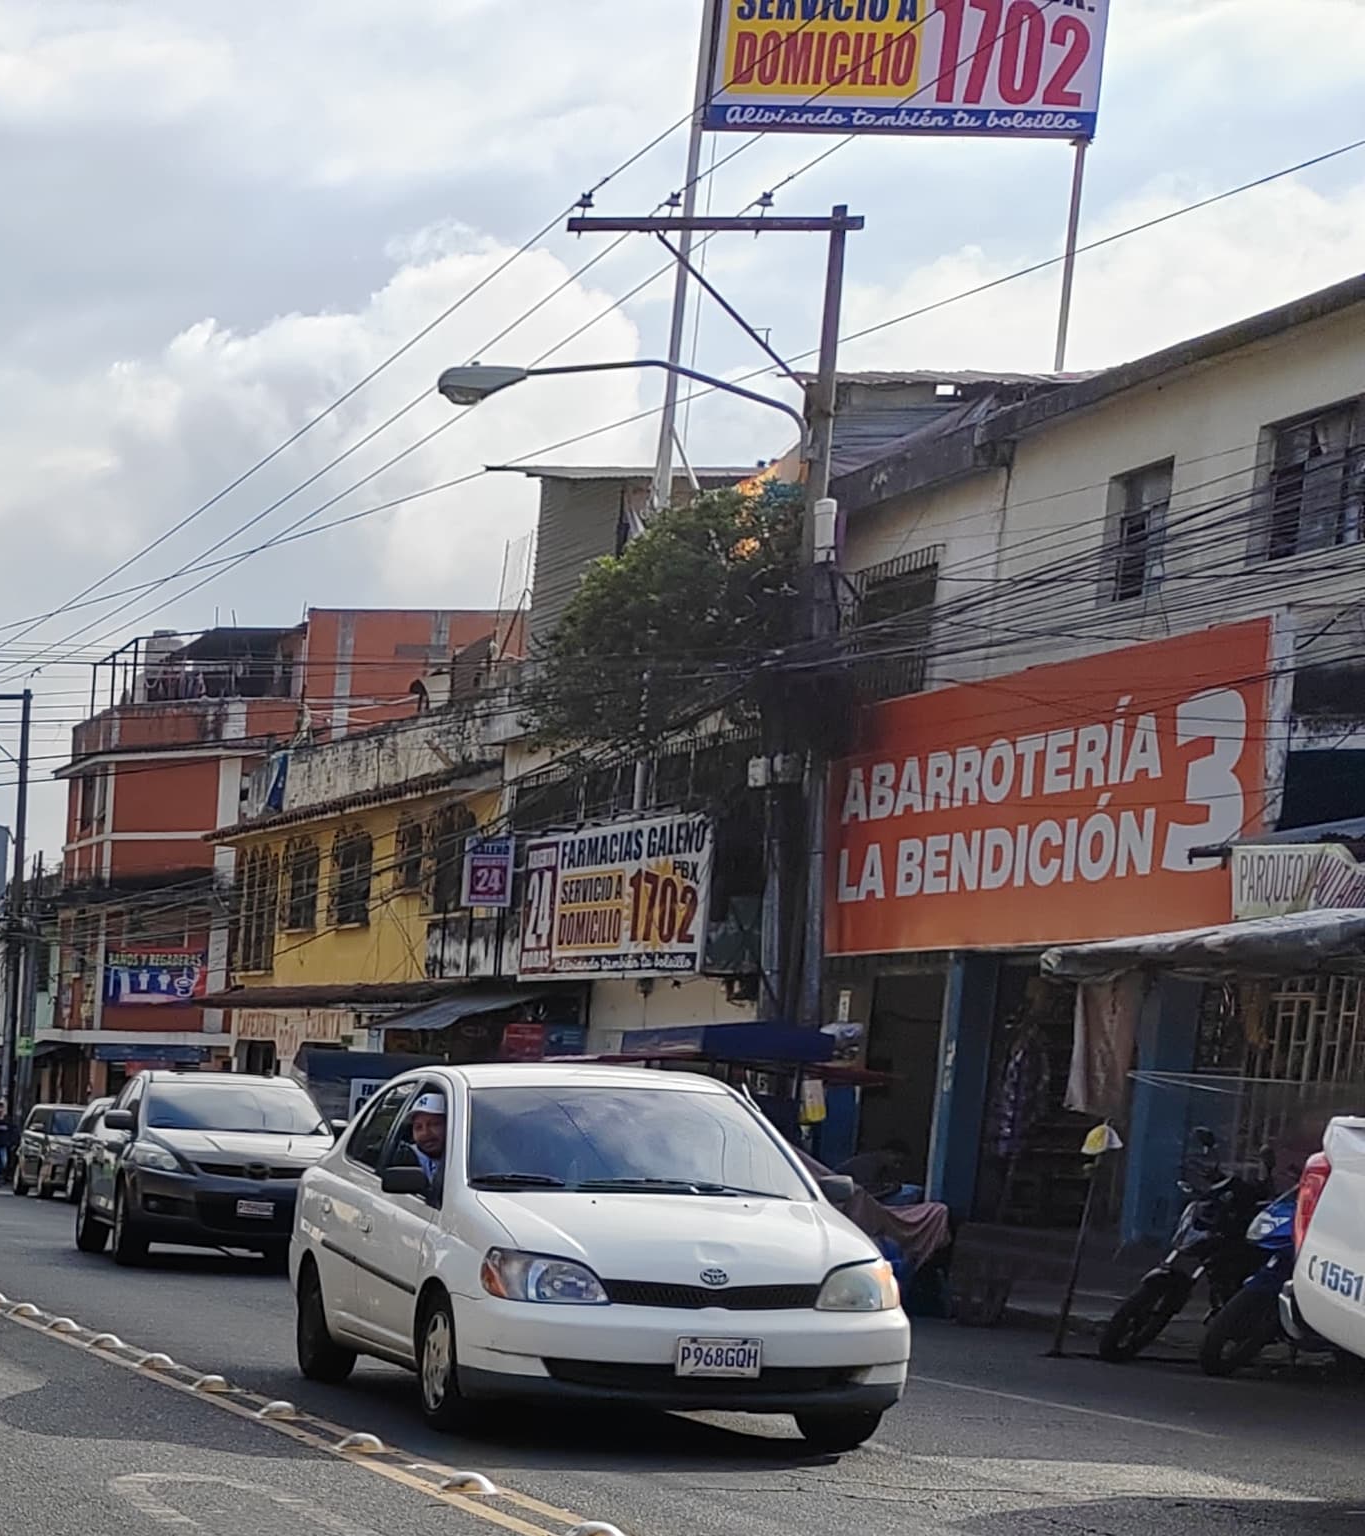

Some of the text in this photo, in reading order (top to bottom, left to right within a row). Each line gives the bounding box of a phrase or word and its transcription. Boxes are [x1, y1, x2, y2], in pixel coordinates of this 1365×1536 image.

[733, 30, 918, 87] DOMICILIO
[934, 0, 1092, 107] 1702
[725, 106, 1082, 131] Aliviando también tu bolsillo
[840, 694, 1164, 825] ABARROTERÍA
[1161, 687, 1247, 873] 3
[560, 829, 644, 870] FARMACIAS
[647, 820, 707, 858] GALENO
[838, 792, 1156, 904] LA BENDICIÓN
[476, 868, 502, 892] 24
[560, 874, 624, 905] SERVICIO A
[629, 867, 699, 944] 1702
[1239, 853, 1304, 907] PARQUEO
[525, 869, 553, 948] 24
[557, 908, 621, 946] DOMICILIO
[681, 1346, 758, 1369] P968GQH
